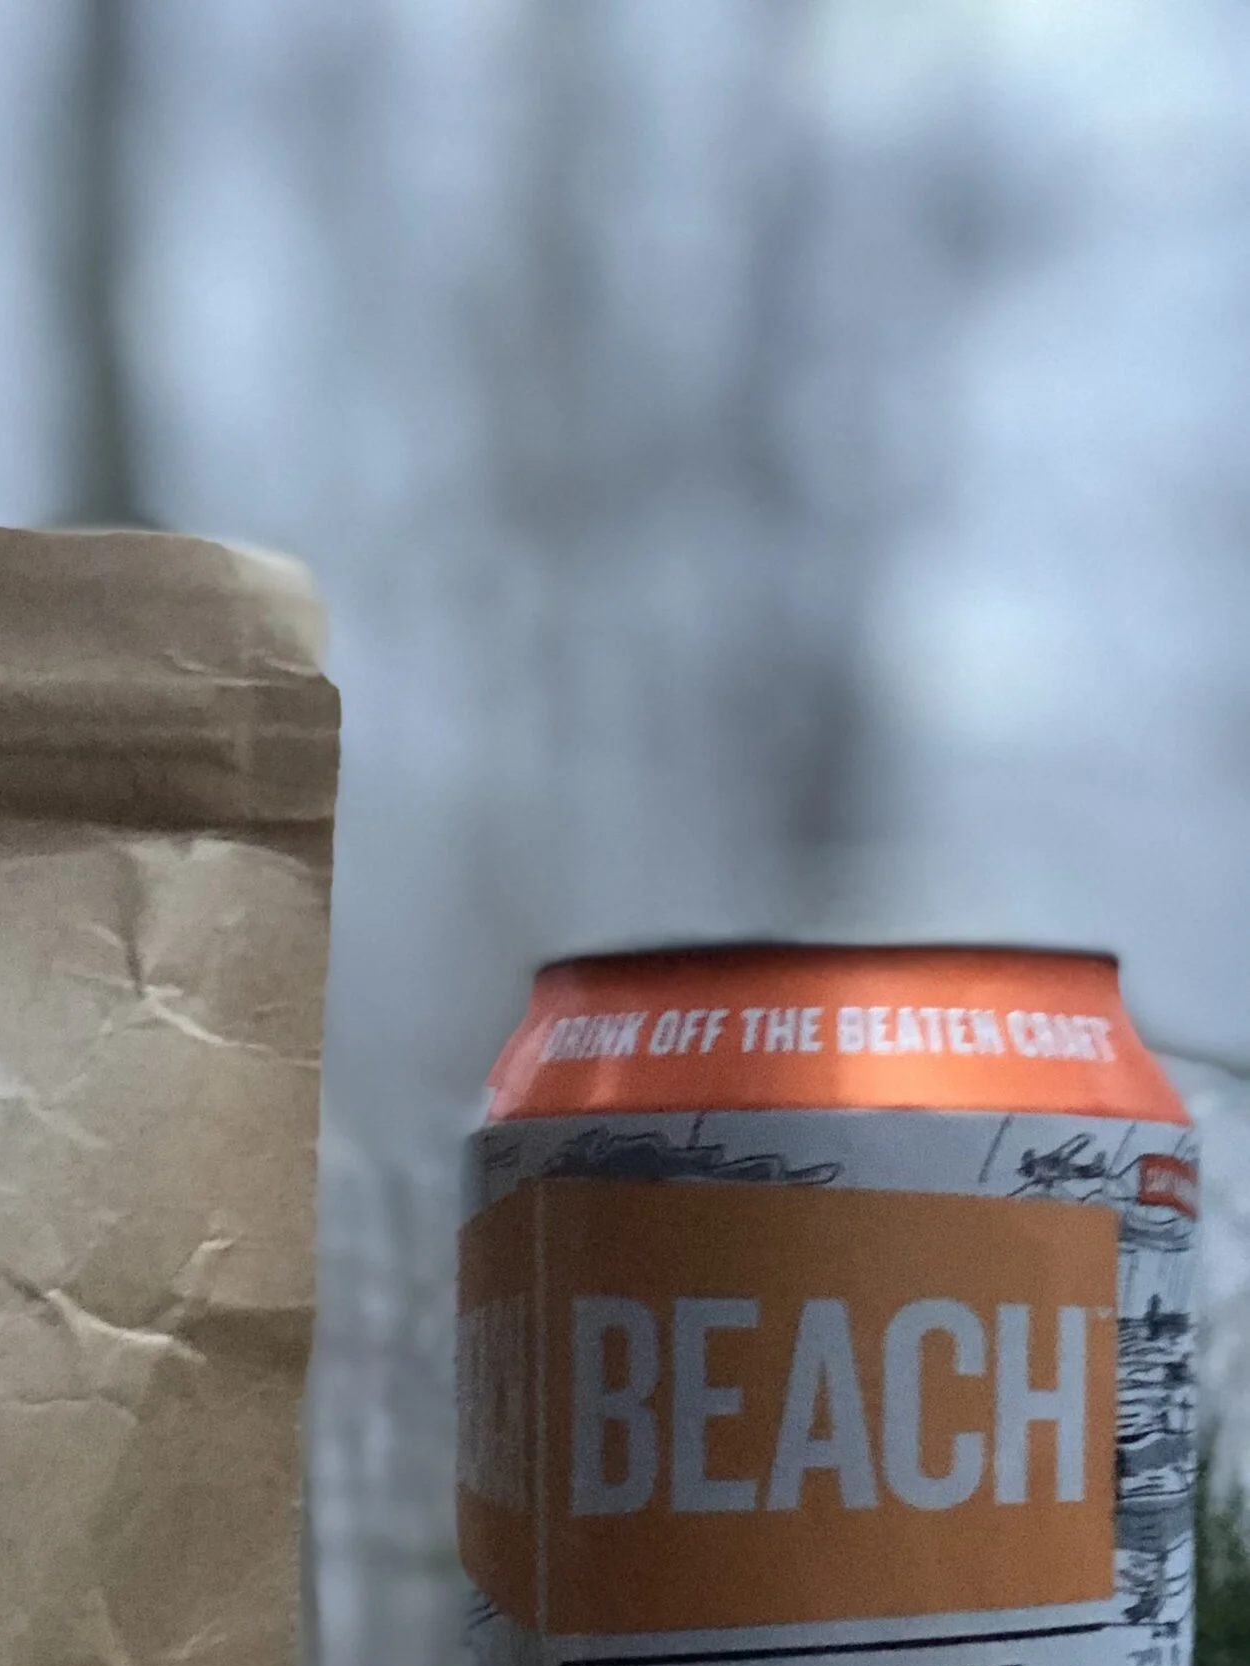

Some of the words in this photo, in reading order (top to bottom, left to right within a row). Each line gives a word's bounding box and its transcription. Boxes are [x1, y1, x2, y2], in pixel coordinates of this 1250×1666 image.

[538, 1011, 649, 1063] DRINK
[648, 1008, 731, 1057] OFF
[740, 1007, 825, 1054] THE
[836, 1005, 1006, 1056] BEATEN
[569, 1294, 1088, 1518] BEACH
